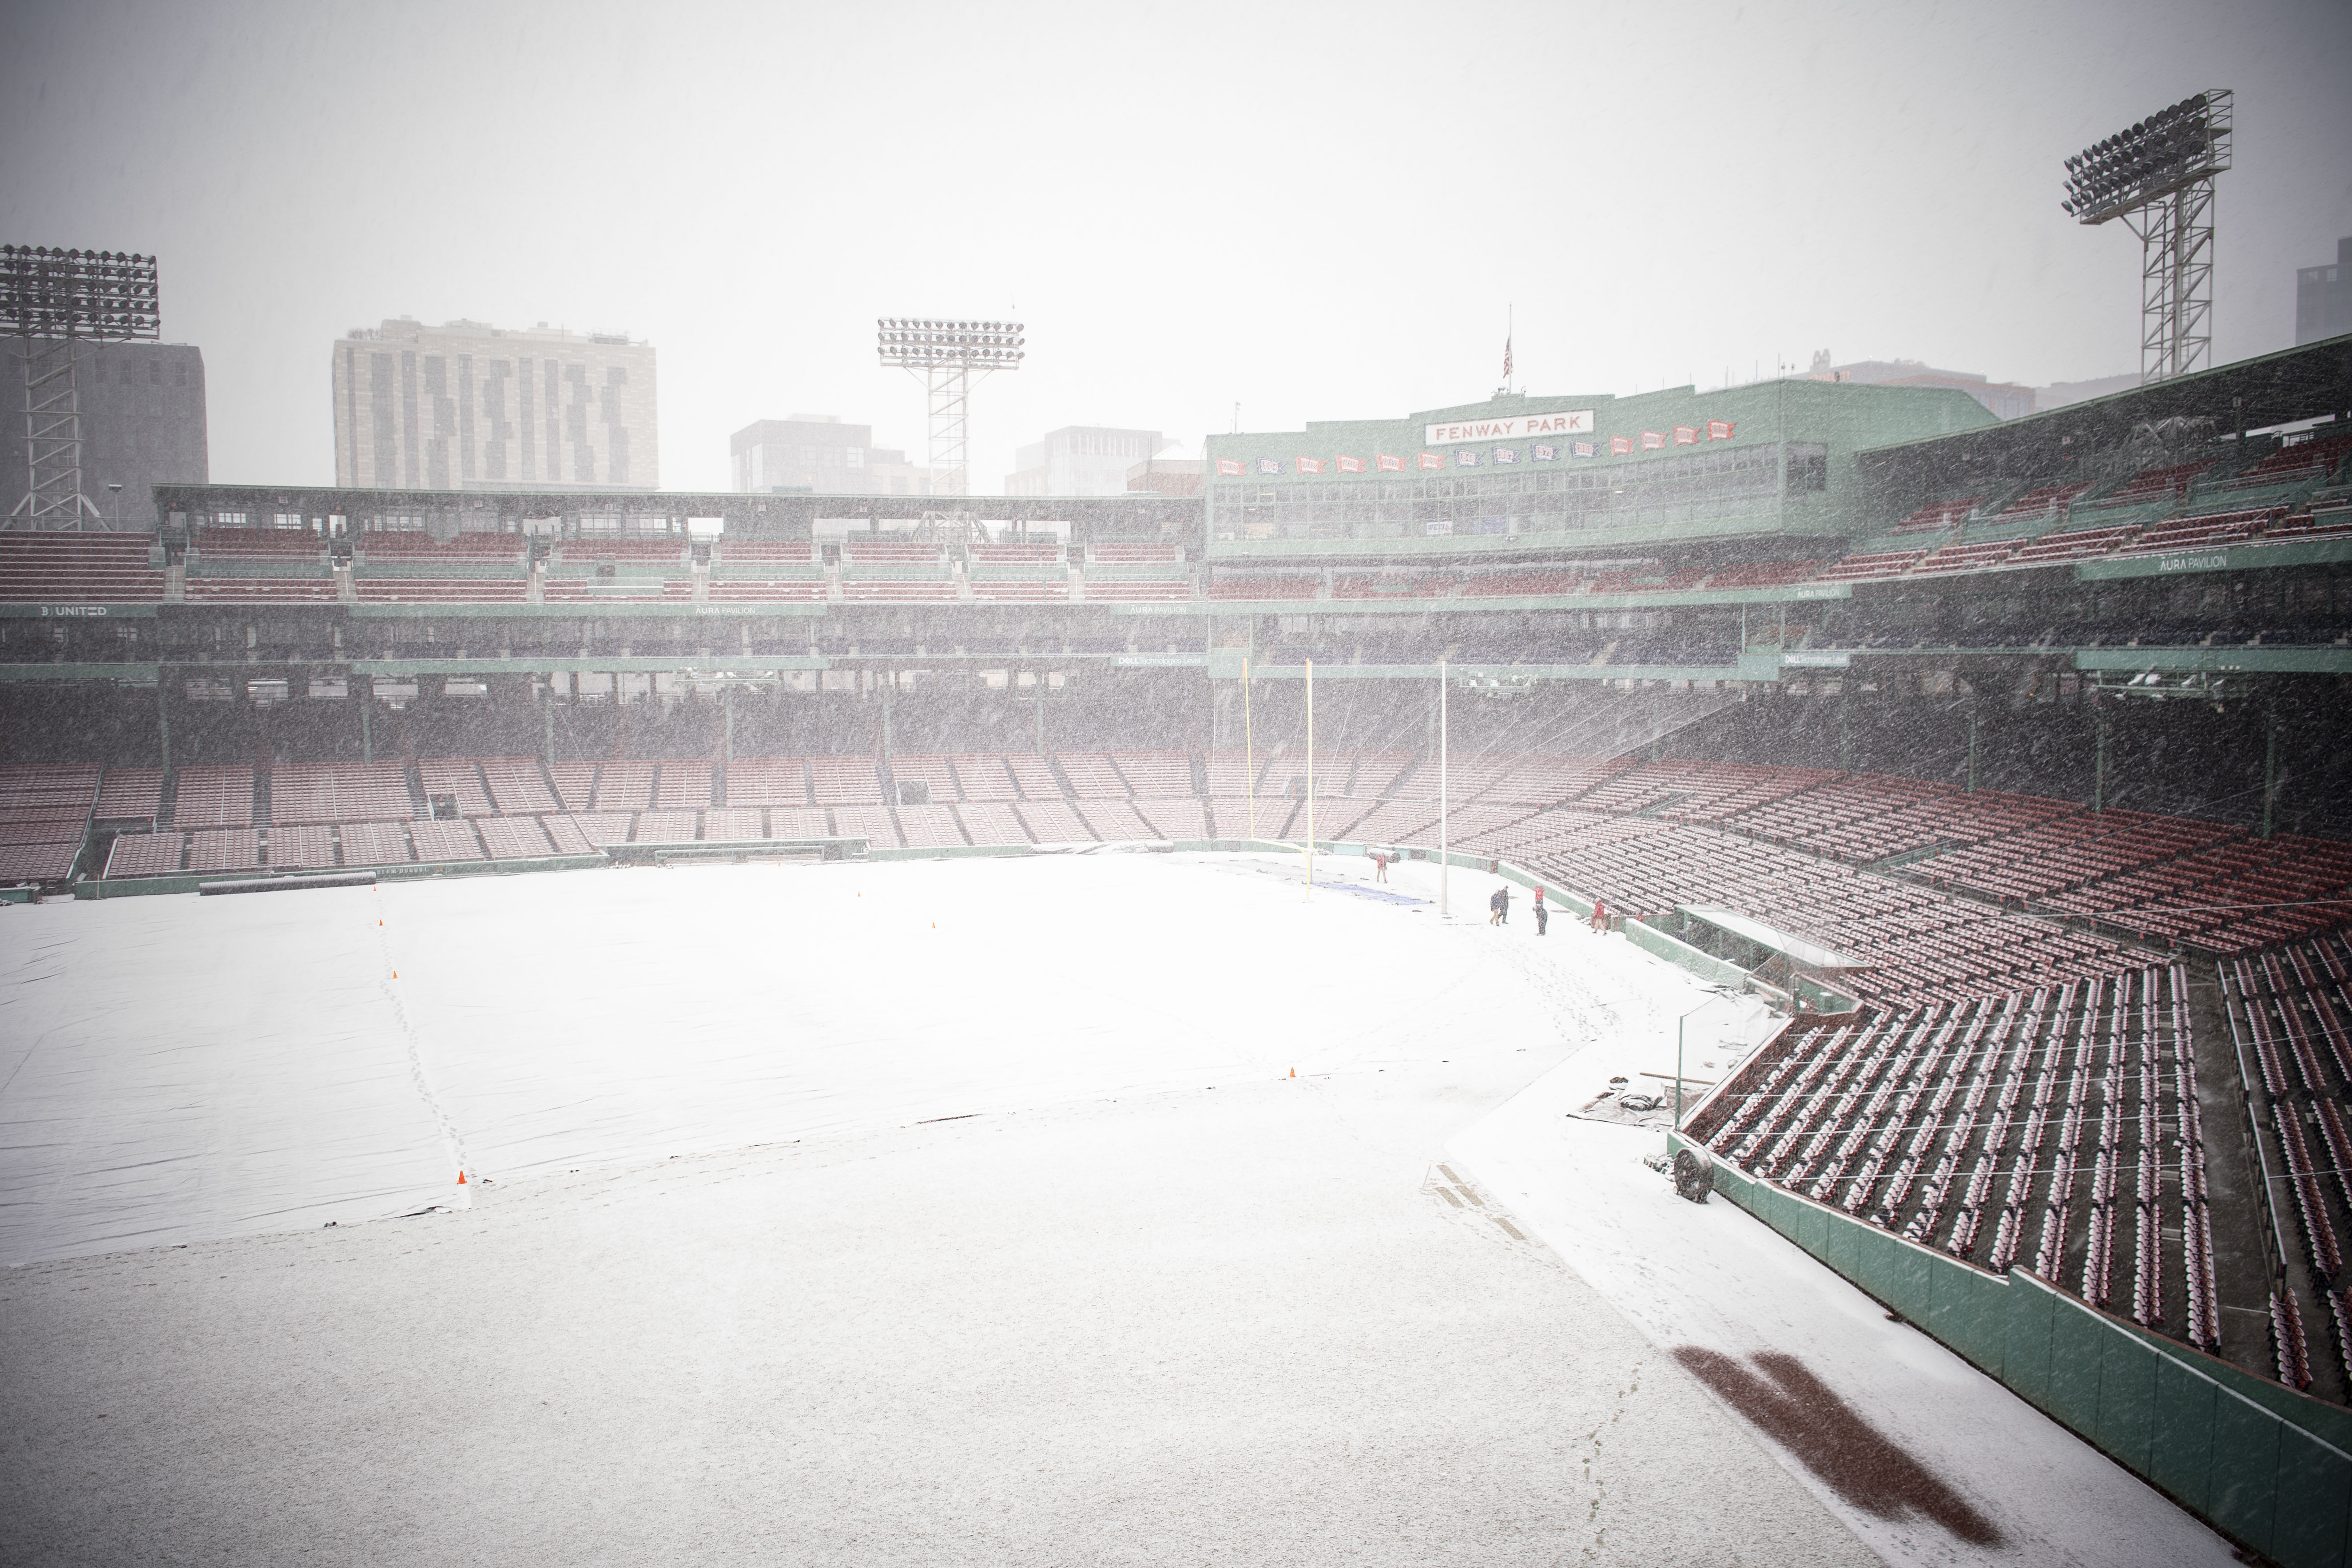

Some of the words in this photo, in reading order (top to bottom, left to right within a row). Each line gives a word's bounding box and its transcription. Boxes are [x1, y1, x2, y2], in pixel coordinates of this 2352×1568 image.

[1436, 422, 1514, 440] FENWAY
[1527, 416, 1581, 432] PARK
[2189, 556, 2226, 568] PAVILION
[56, 607, 107, 615] UNITED
[1785, 655, 1800, 663] DELL
